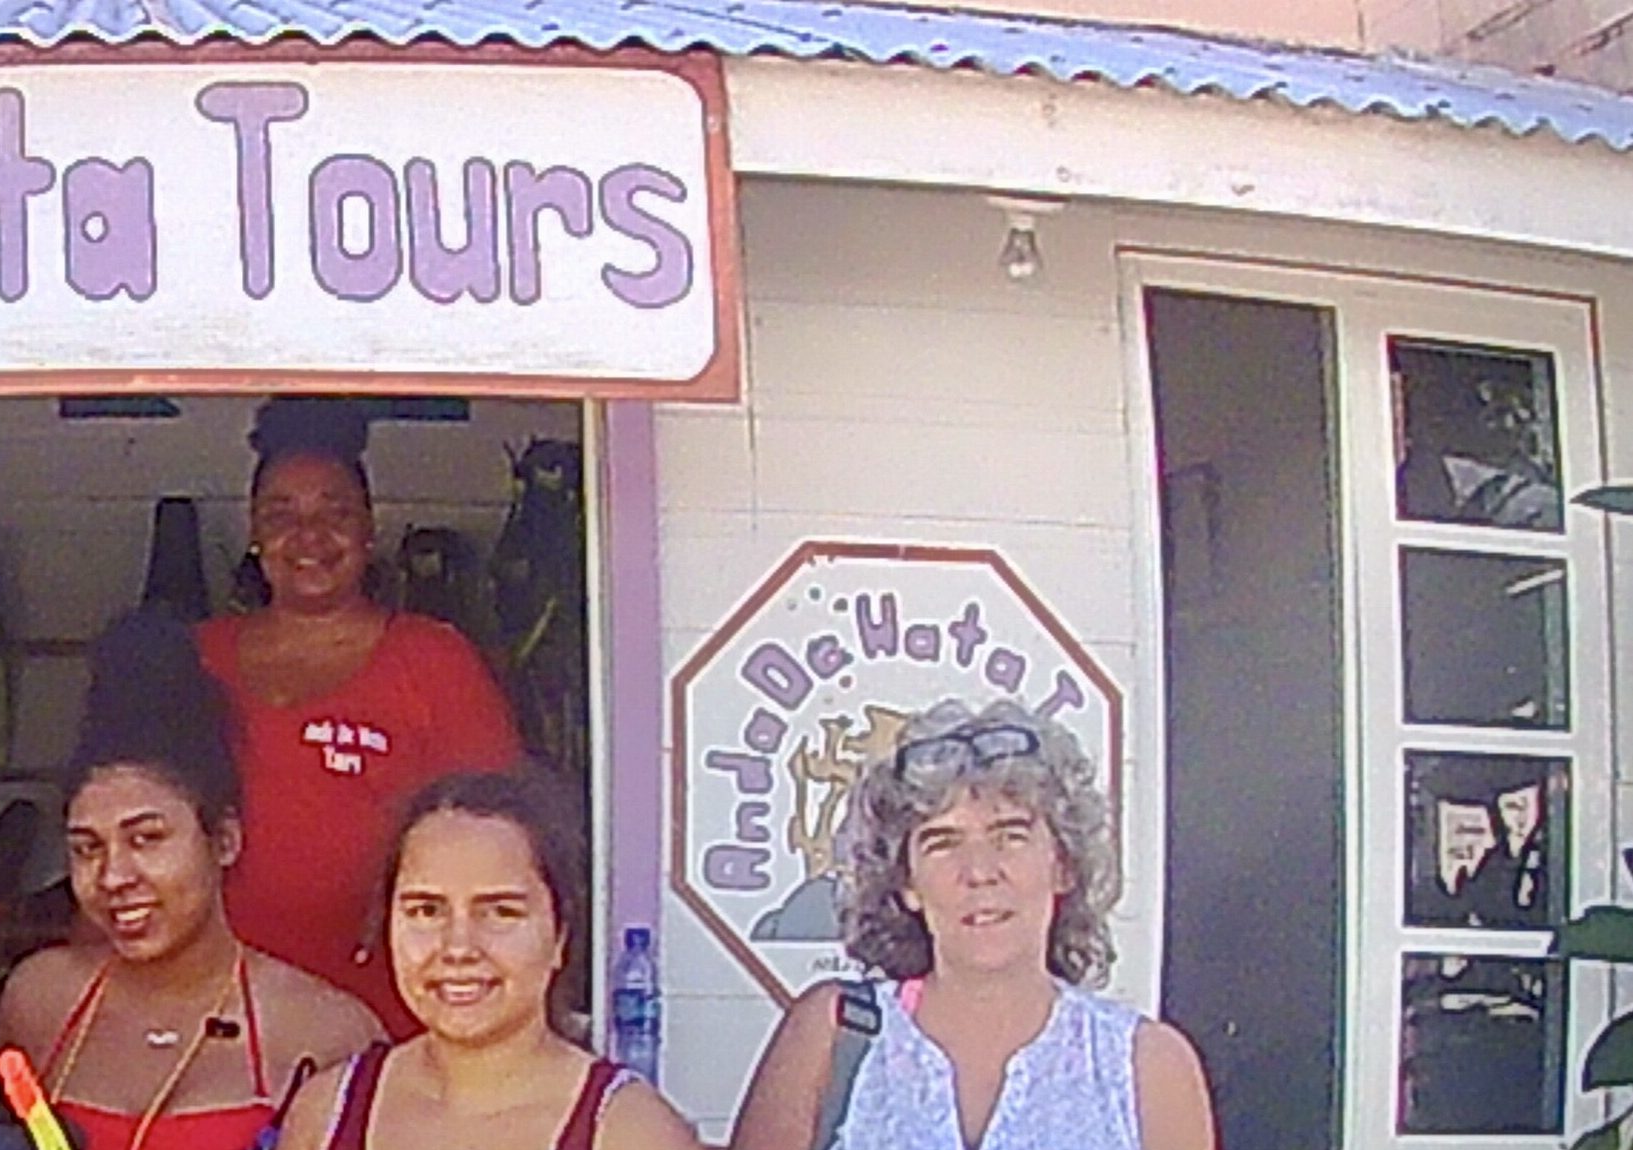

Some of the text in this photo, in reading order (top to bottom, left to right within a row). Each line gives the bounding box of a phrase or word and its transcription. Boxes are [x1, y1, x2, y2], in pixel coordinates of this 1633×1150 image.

[195, 81, 693, 309] Tours
[739, 633, 854, 713] De
[854, 592, 1029, 694] Wata
[703, 707, 788, 891] Anda
